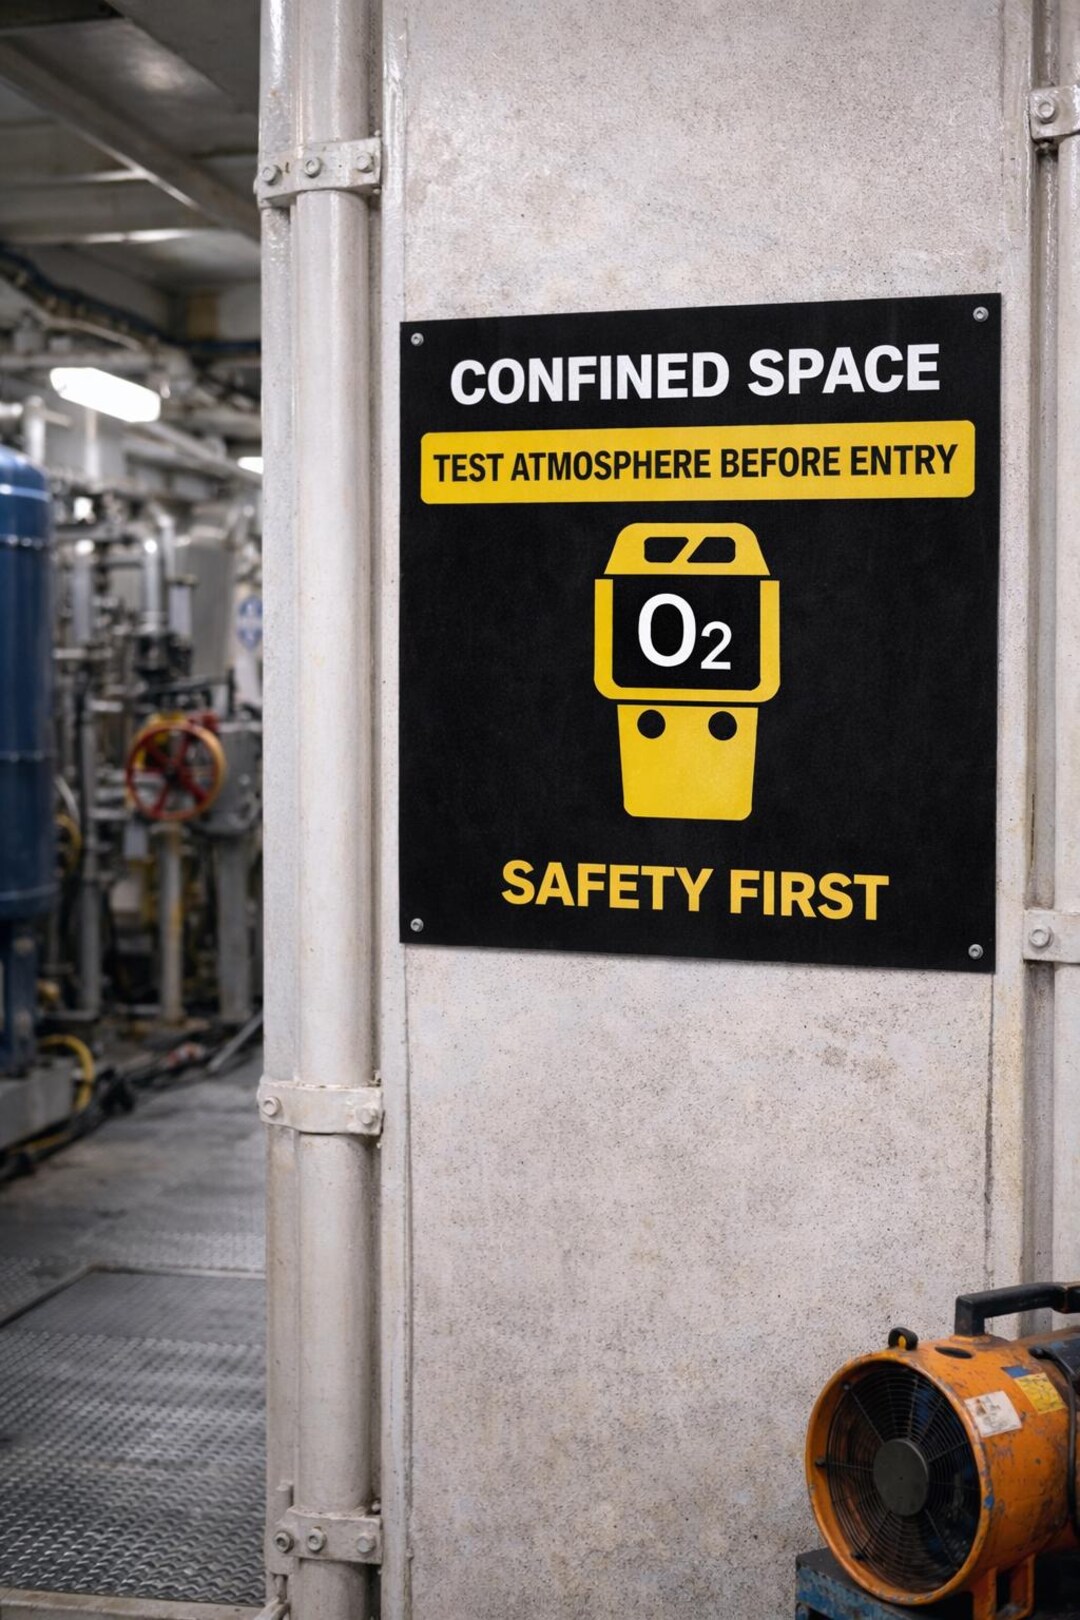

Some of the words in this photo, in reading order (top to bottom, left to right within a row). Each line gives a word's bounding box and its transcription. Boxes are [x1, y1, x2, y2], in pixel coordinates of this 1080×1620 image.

[450, 352, 730, 406] CONFINED
[747, 343, 940, 397] SPACE
[433, 452, 504, 483] TEST
[510, 448, 711, 481] ATMOSPHERE
[720, 446, 841, 478] BEFORE
[850, 444, 958, 477] ENTRY
[638, 593, 732, 670] O2
[501, 859, 714, 912] SAFETY
[730, 869, 890, 921] FIRST
